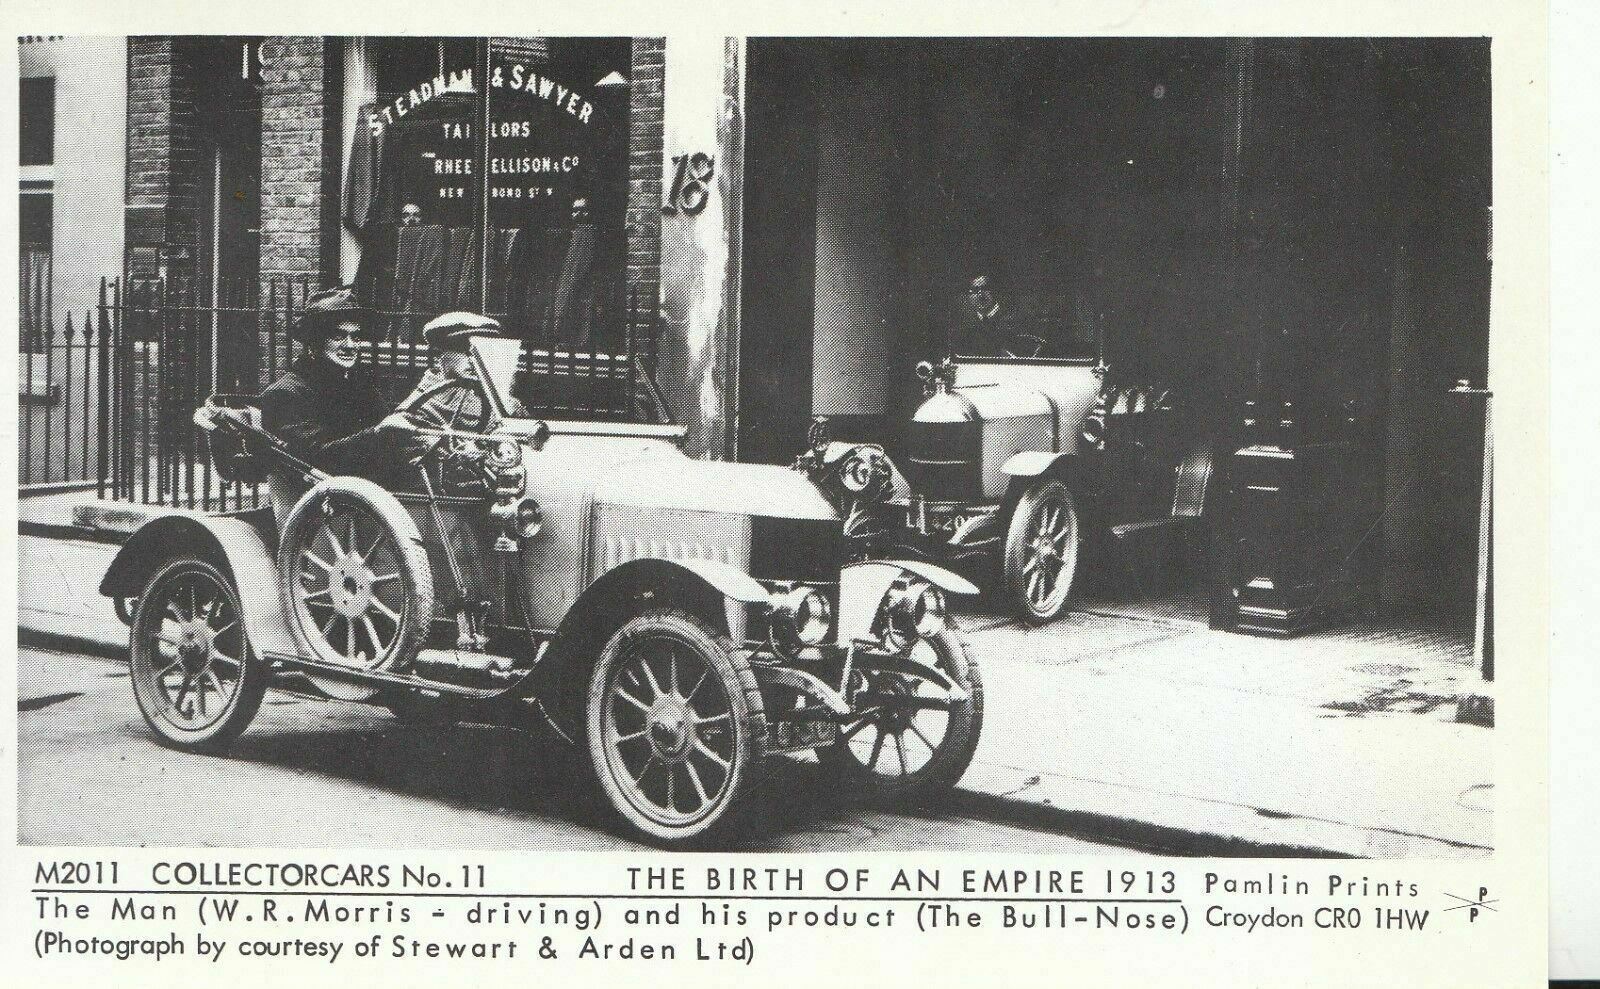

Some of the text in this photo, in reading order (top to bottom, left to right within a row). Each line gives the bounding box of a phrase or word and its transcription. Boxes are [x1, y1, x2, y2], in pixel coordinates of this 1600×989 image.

[367, 64, 594, 137] STEADMAN & SAWYER
[491, 157, 551, 173] ELLISON
[660, 152, 715, 216] 18
[439, 188, 464, 198] NEW
[492, 187, 521, 198] BOND
